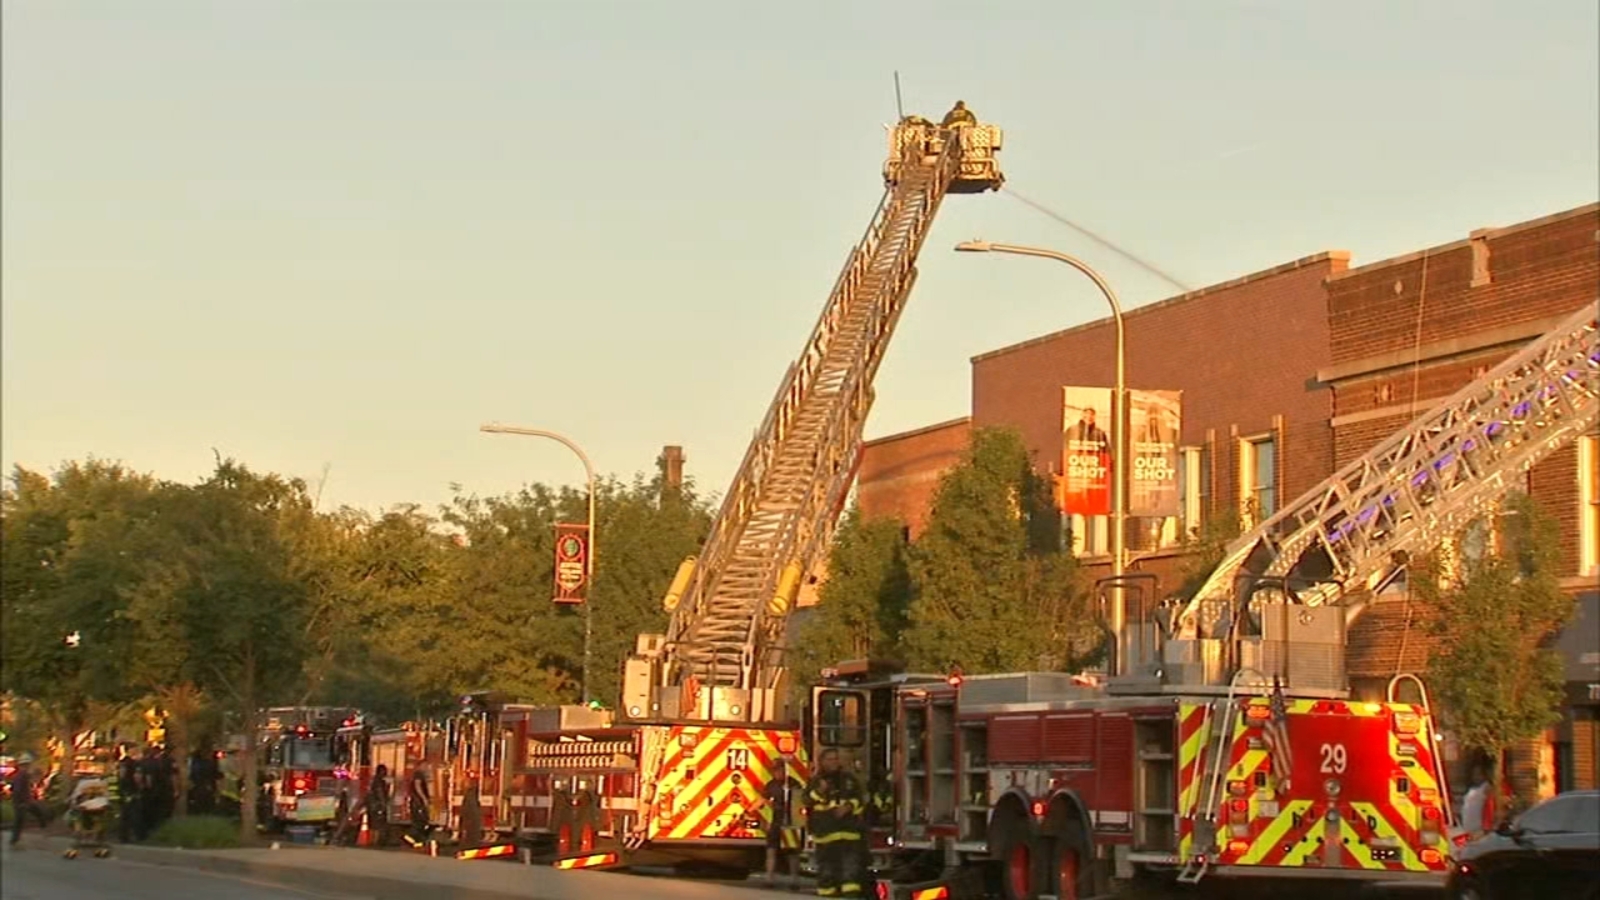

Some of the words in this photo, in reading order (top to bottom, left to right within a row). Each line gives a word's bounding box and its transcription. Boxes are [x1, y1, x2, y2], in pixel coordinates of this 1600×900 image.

[1068, 454, 1099, 466] OUR
[1135, 456, 1166, 468] OUR
[1068, 466, 1106, 478] SHOT
[1135, 468, 1175, 480] SHOT
[728, 749, 747, 770] 14
[1320, 743, 1346, 774] 29
